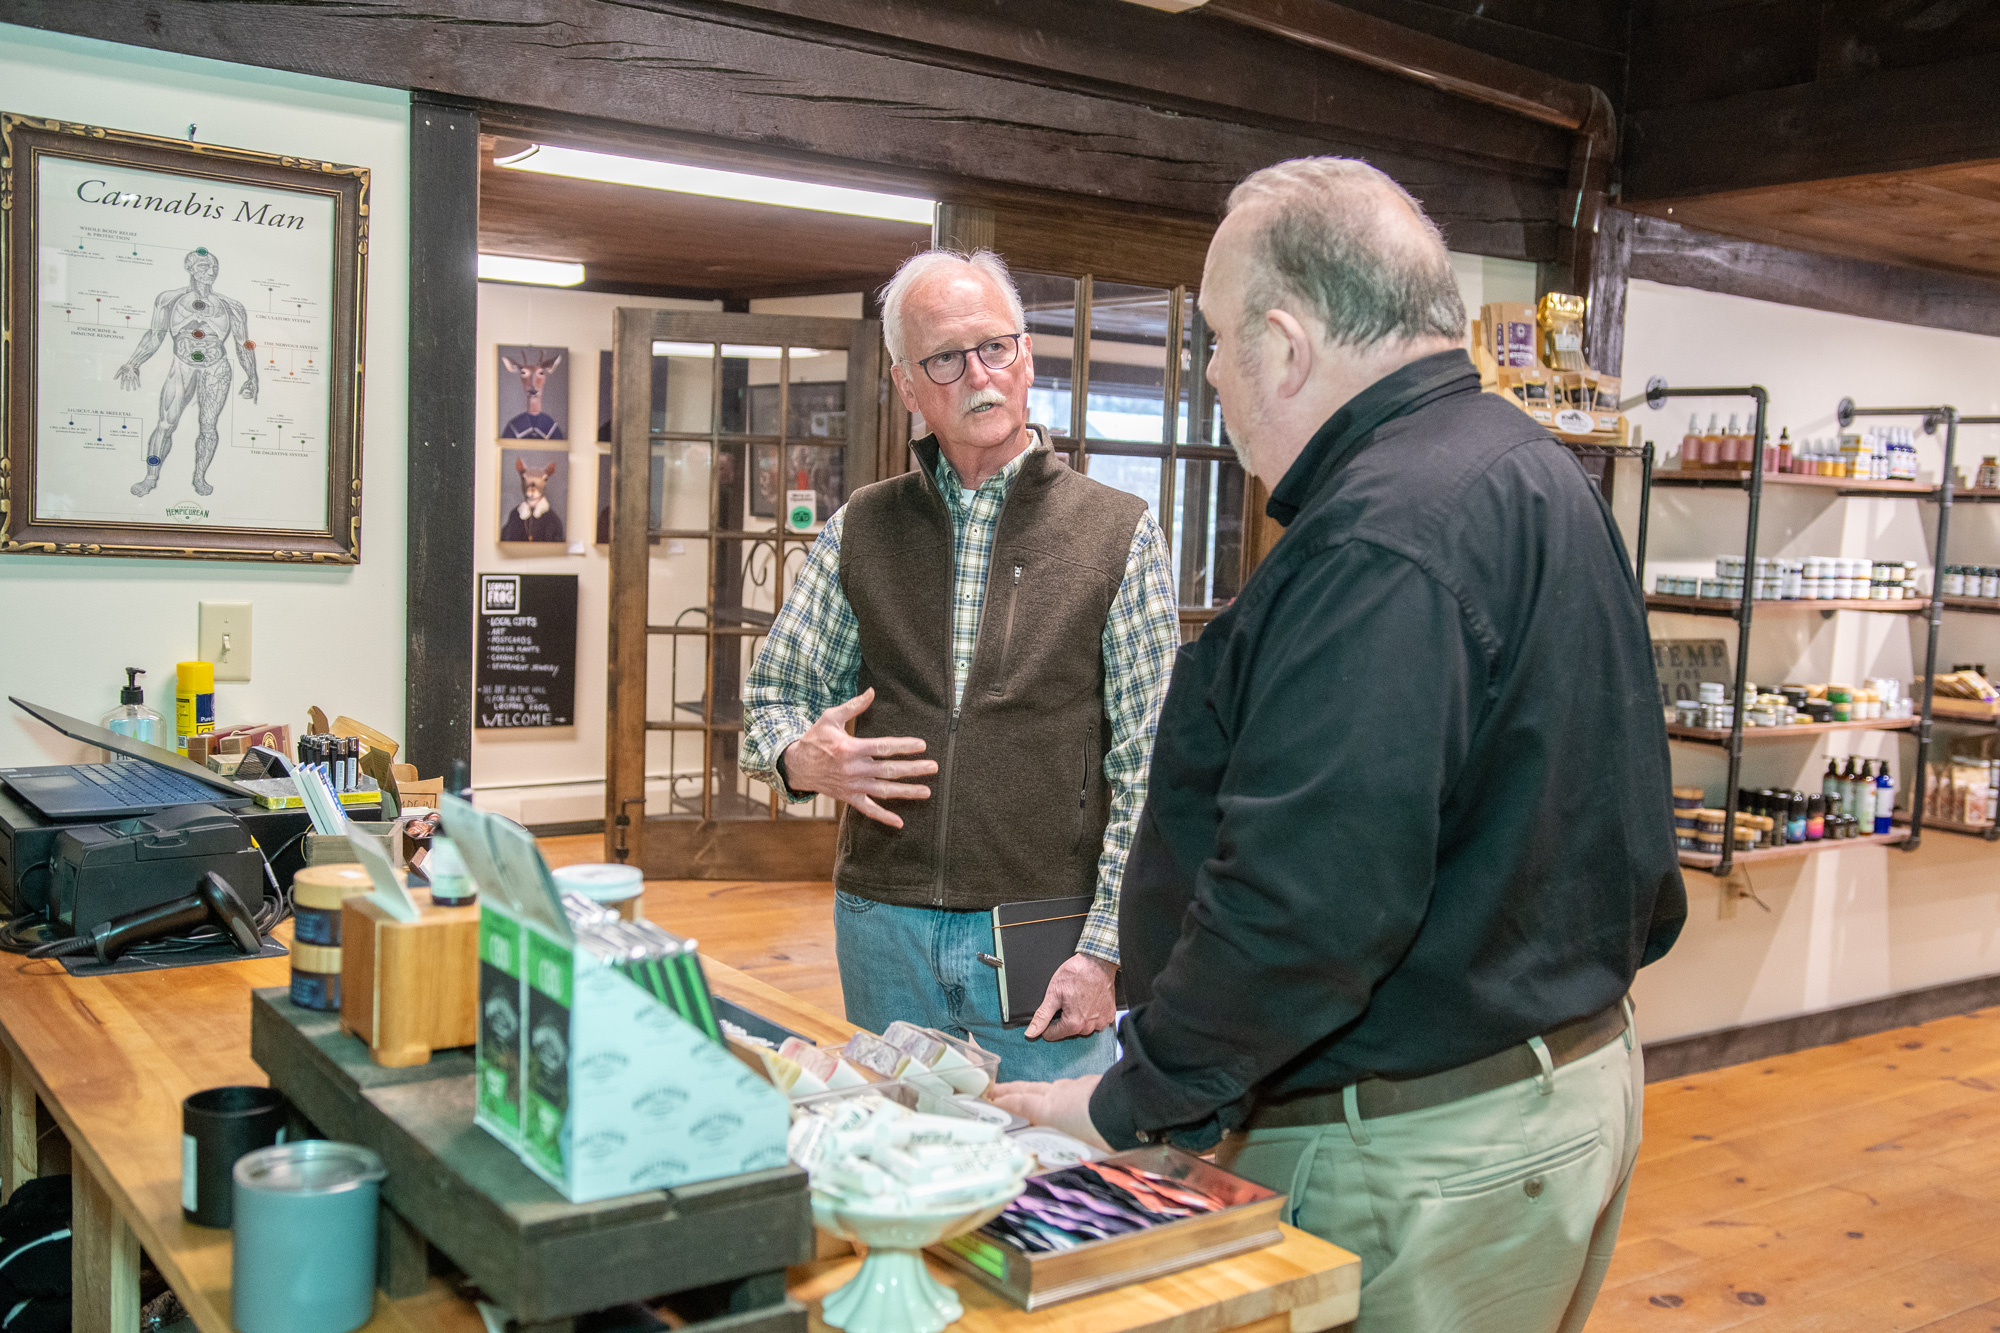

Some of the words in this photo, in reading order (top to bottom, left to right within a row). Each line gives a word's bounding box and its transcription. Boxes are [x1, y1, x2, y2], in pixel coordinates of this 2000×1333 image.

[76, 179, 224, 219] Cannabis
[232, 200, 305, 230] Man
[93, 233, 131, 241] PROTECTION
[255, 314, 291, 322] CIRCULATORY
[76, 326, 112, 334] ENDOCRINE
[487, 591, 515, 604] FROG
[481, 712, 552, 728] WELCOME
